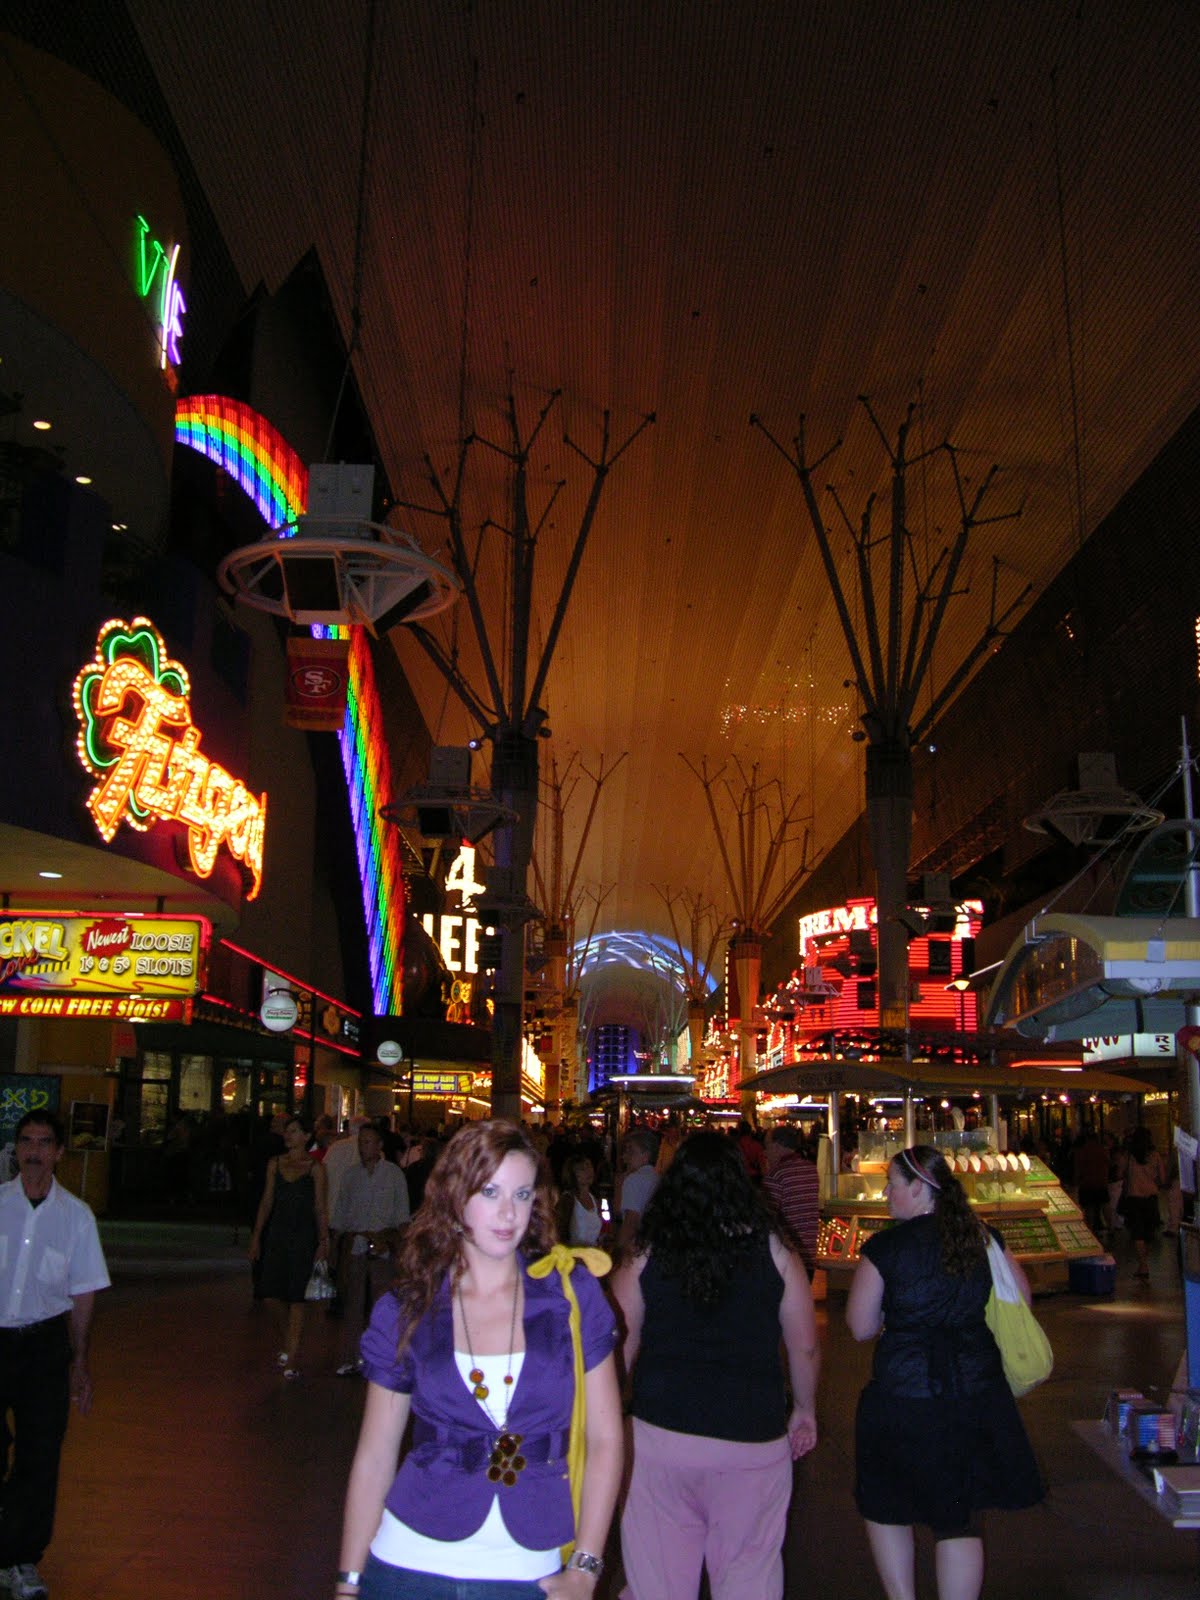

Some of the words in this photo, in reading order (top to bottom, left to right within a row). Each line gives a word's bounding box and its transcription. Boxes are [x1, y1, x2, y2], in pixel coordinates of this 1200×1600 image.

[86, 926, 129, 951] Newest
[130, 933, 193, 952] LOOSE
[135, 957, 193, 976] SLOTS
[20, 997, 64, 1014] COIN
[66, 999, 114, 1016] FREE
